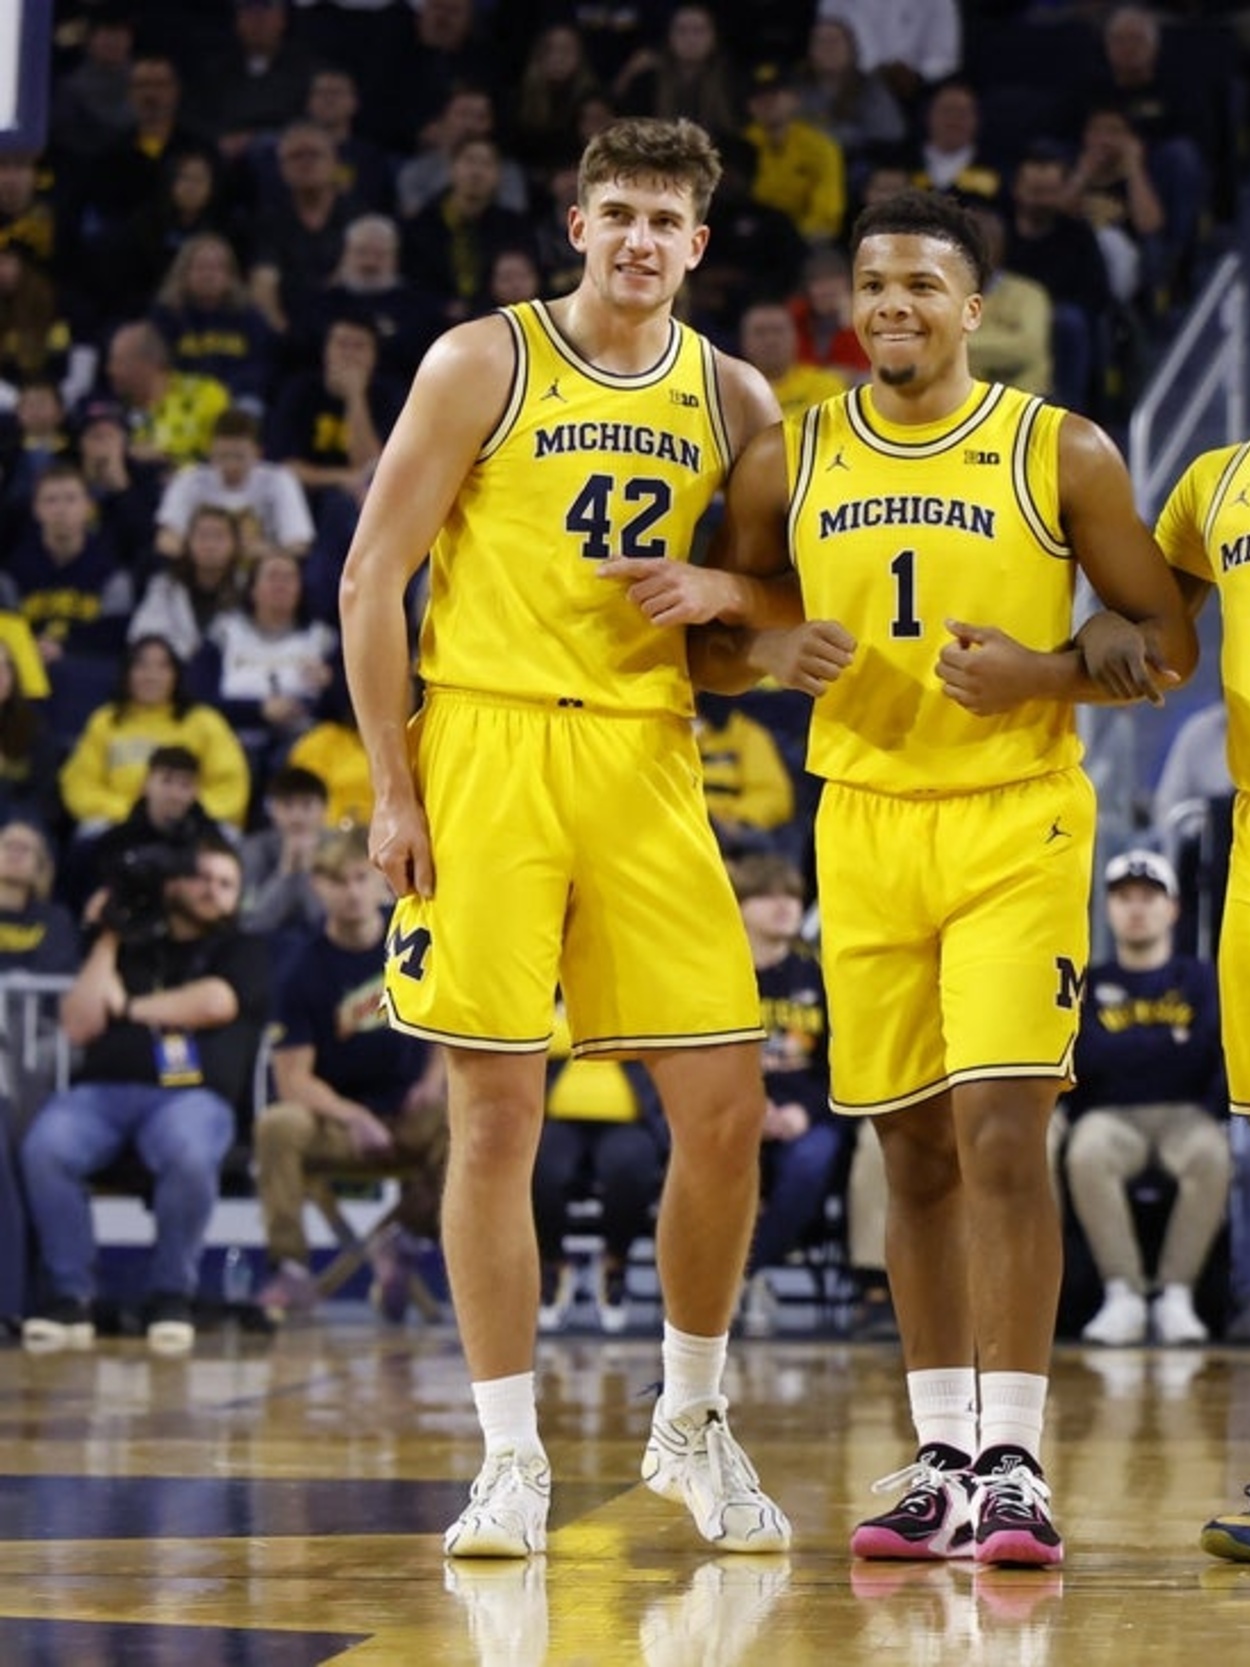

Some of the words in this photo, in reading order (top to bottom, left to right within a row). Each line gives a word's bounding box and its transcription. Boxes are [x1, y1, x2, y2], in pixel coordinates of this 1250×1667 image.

[535, 422, 700, 473] MICHIGAN
[566, 474, 671, 560] 42
[820, 496, 995, 539] MICHIGAN
[891, 551, 921, 637] 1
